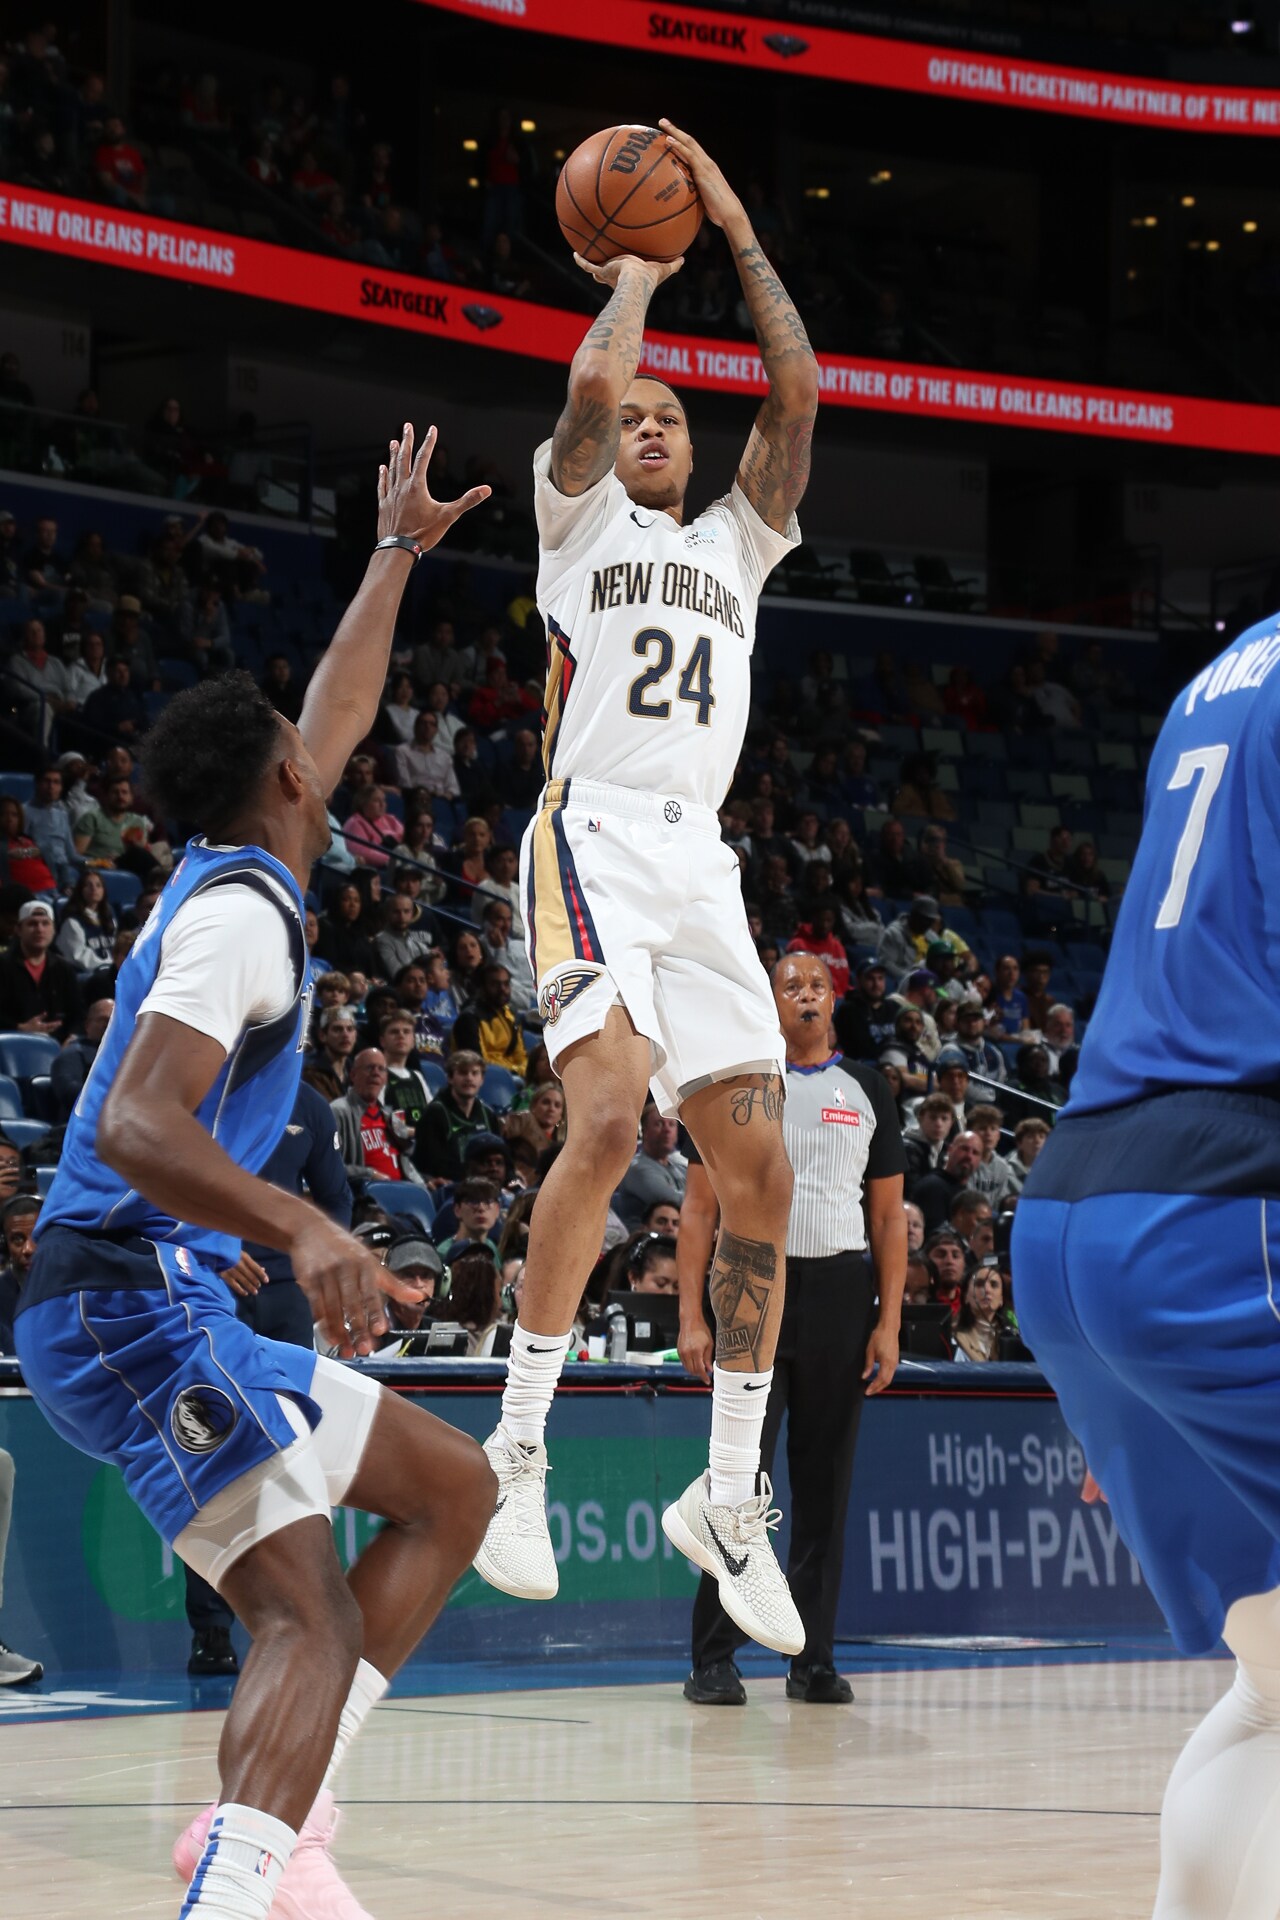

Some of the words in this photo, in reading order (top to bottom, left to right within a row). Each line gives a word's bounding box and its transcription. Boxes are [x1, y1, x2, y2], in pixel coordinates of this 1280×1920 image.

[648, 14, 747, 51] SEATGEEK
[928, 57, 1005, 92] OFFICIAL
[1009, 69, 1098, 107] TICKETING
[1102, 84, 1182, 117] PARTNER
[1185, 95, 1206, 119] OF
[1213, 98, 1249, 123] THE
[1253, 102, 1280, 125] NE
[10, 199, 54, 235] NEW
[57, 210, 143, 256] ORLEANS
[146, 230, 235, 276] PELICANS
[360, 278, 448, 324] SEATGEEK
[818, 365, 887, 398] ARTNER
[890, 374, 914, 400] OF
[917, 378, 951, 405] THE
[955, 381, 997, 411] NEW
[1000, 386, 1083, 421] ORLEANS
[1086, 396, 1173, 432] PELICANS
[590, 562, 654, 613] NEW
[660, 560, 746, 640] ORLEANS
[626, 626, 716, 727] 24
[1154, 743, 1230, 930] 7
[822, 1110, 860, 1125] Emirates
[928, 1432, 1085, 1498] High-Spe
